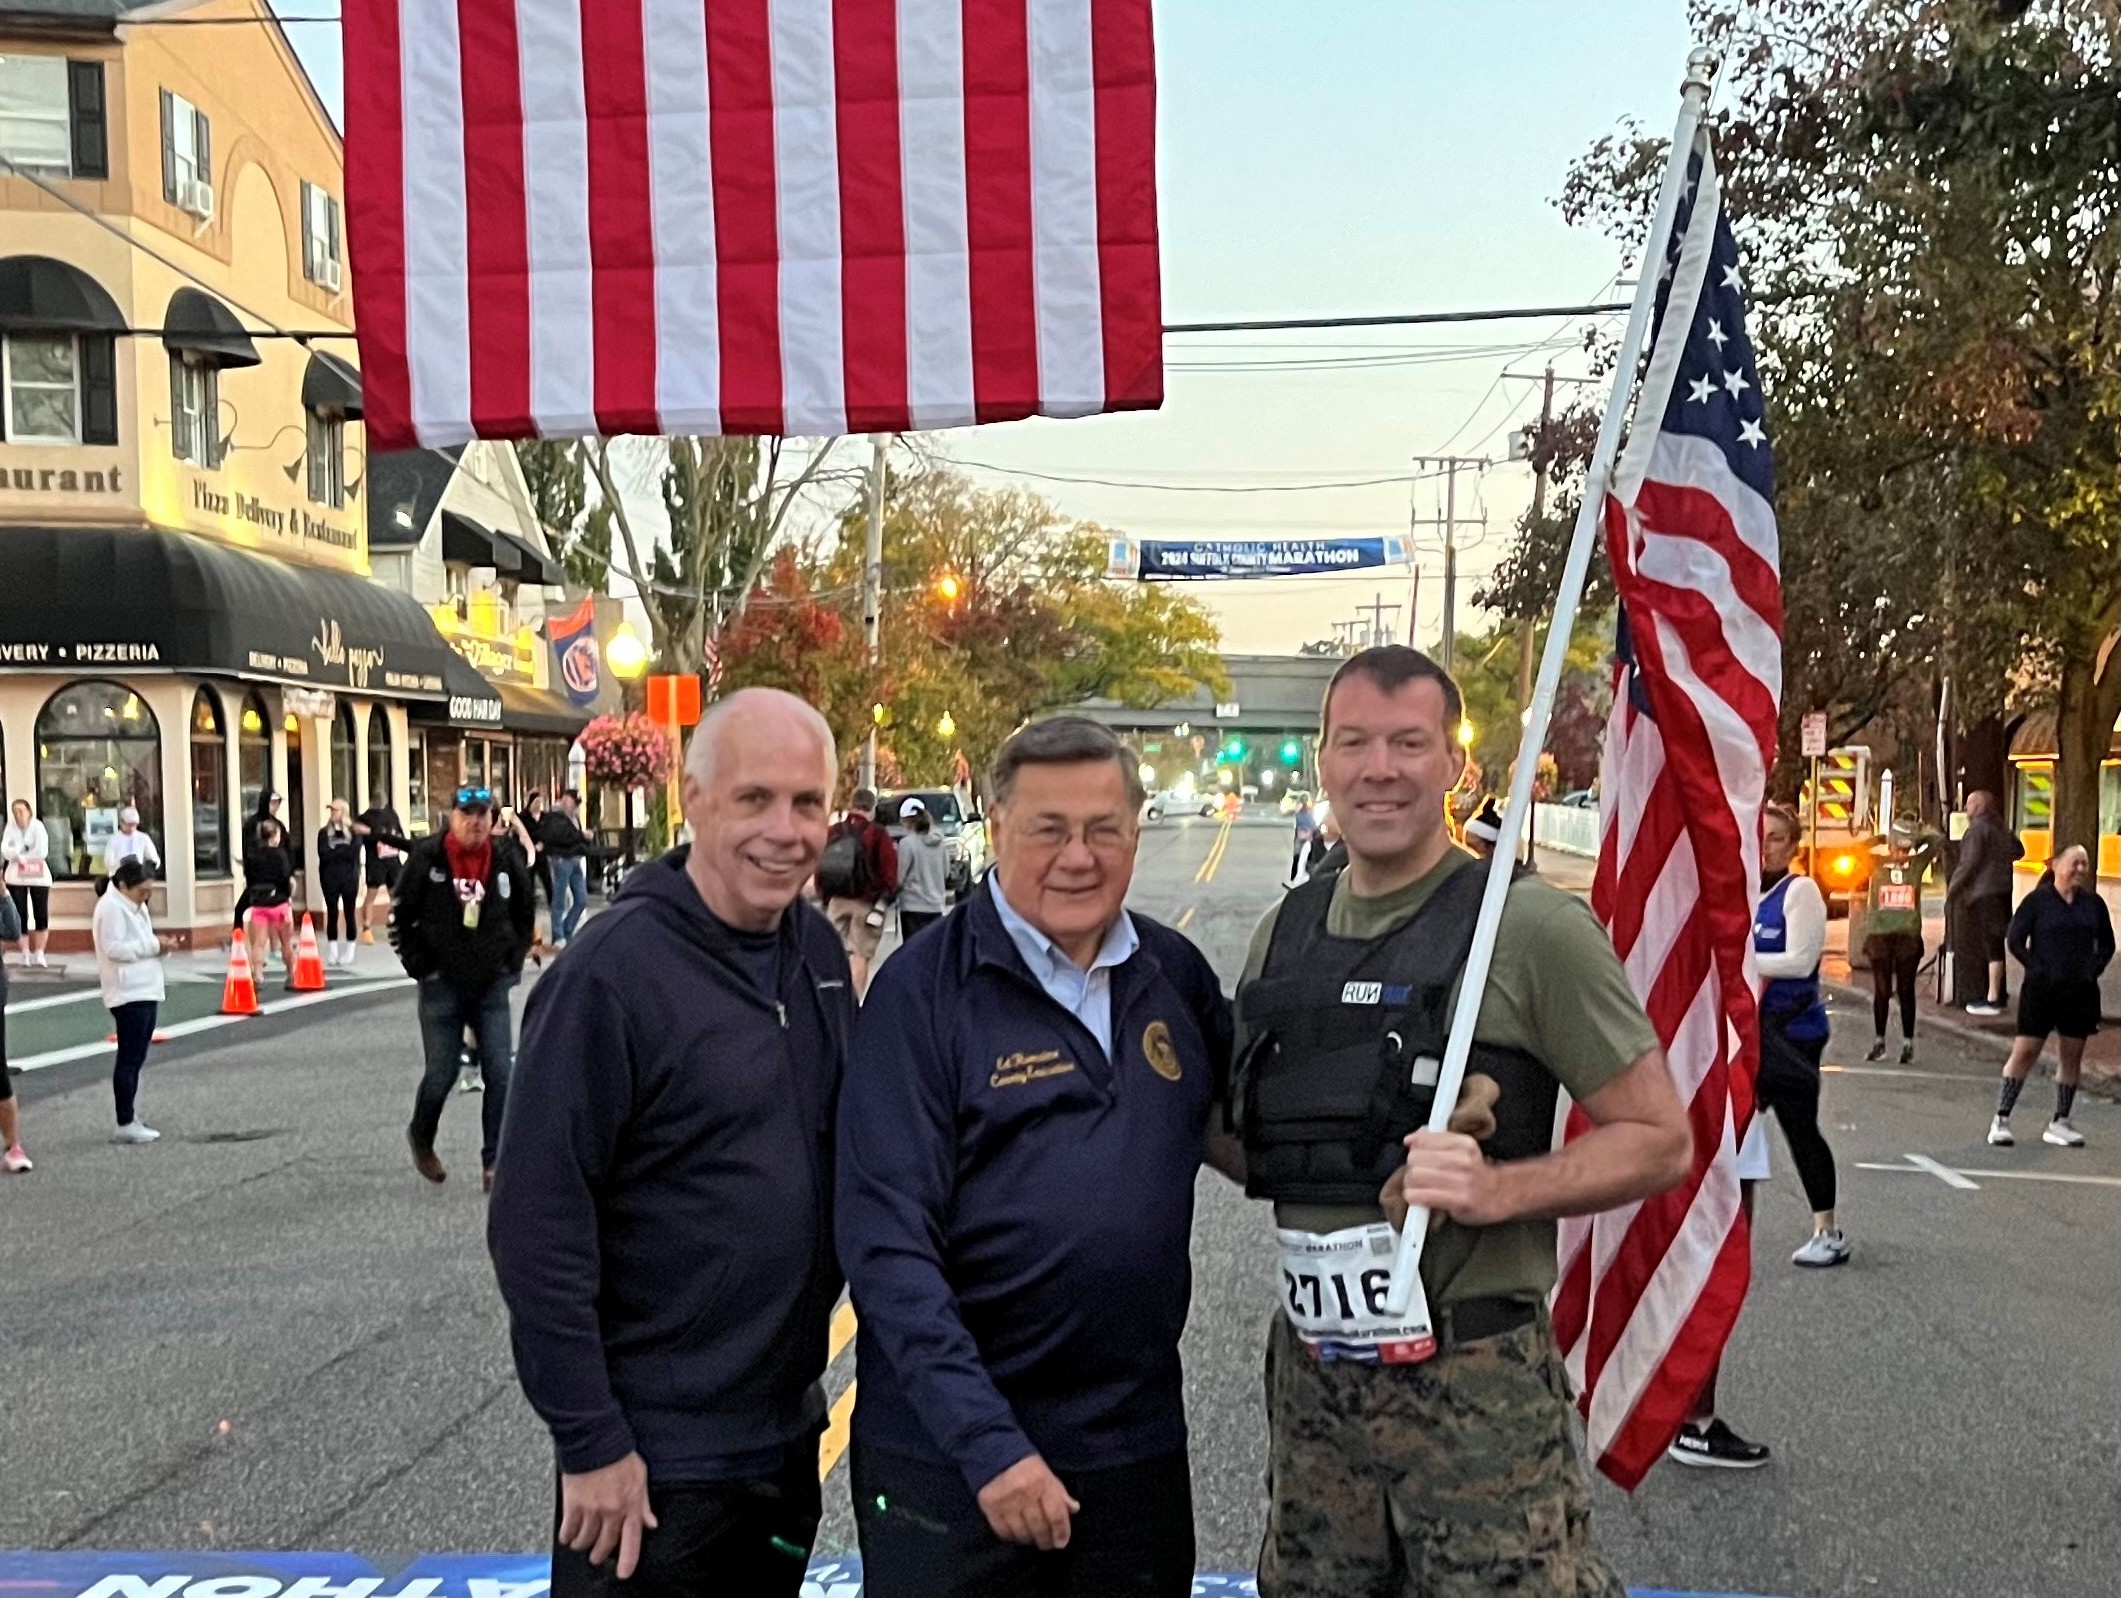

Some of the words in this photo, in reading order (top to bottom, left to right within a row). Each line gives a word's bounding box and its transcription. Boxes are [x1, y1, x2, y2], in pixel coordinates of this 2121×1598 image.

[194, 479, 229, 515] Pizza
[235, 491, 284, 536] Delivery
[290, 507, 299, 535] &
[1272, 541, 1325, 552] HEALTH
[1268, 549, 1360, 565] MARATHON
[0, 643, 48, 661] VERY
[76, 643, 160, 661] PIZZERIA
[1343, 984, 1380, 1003] RUN
[1283, 1268, 1391, 1320] 2716
